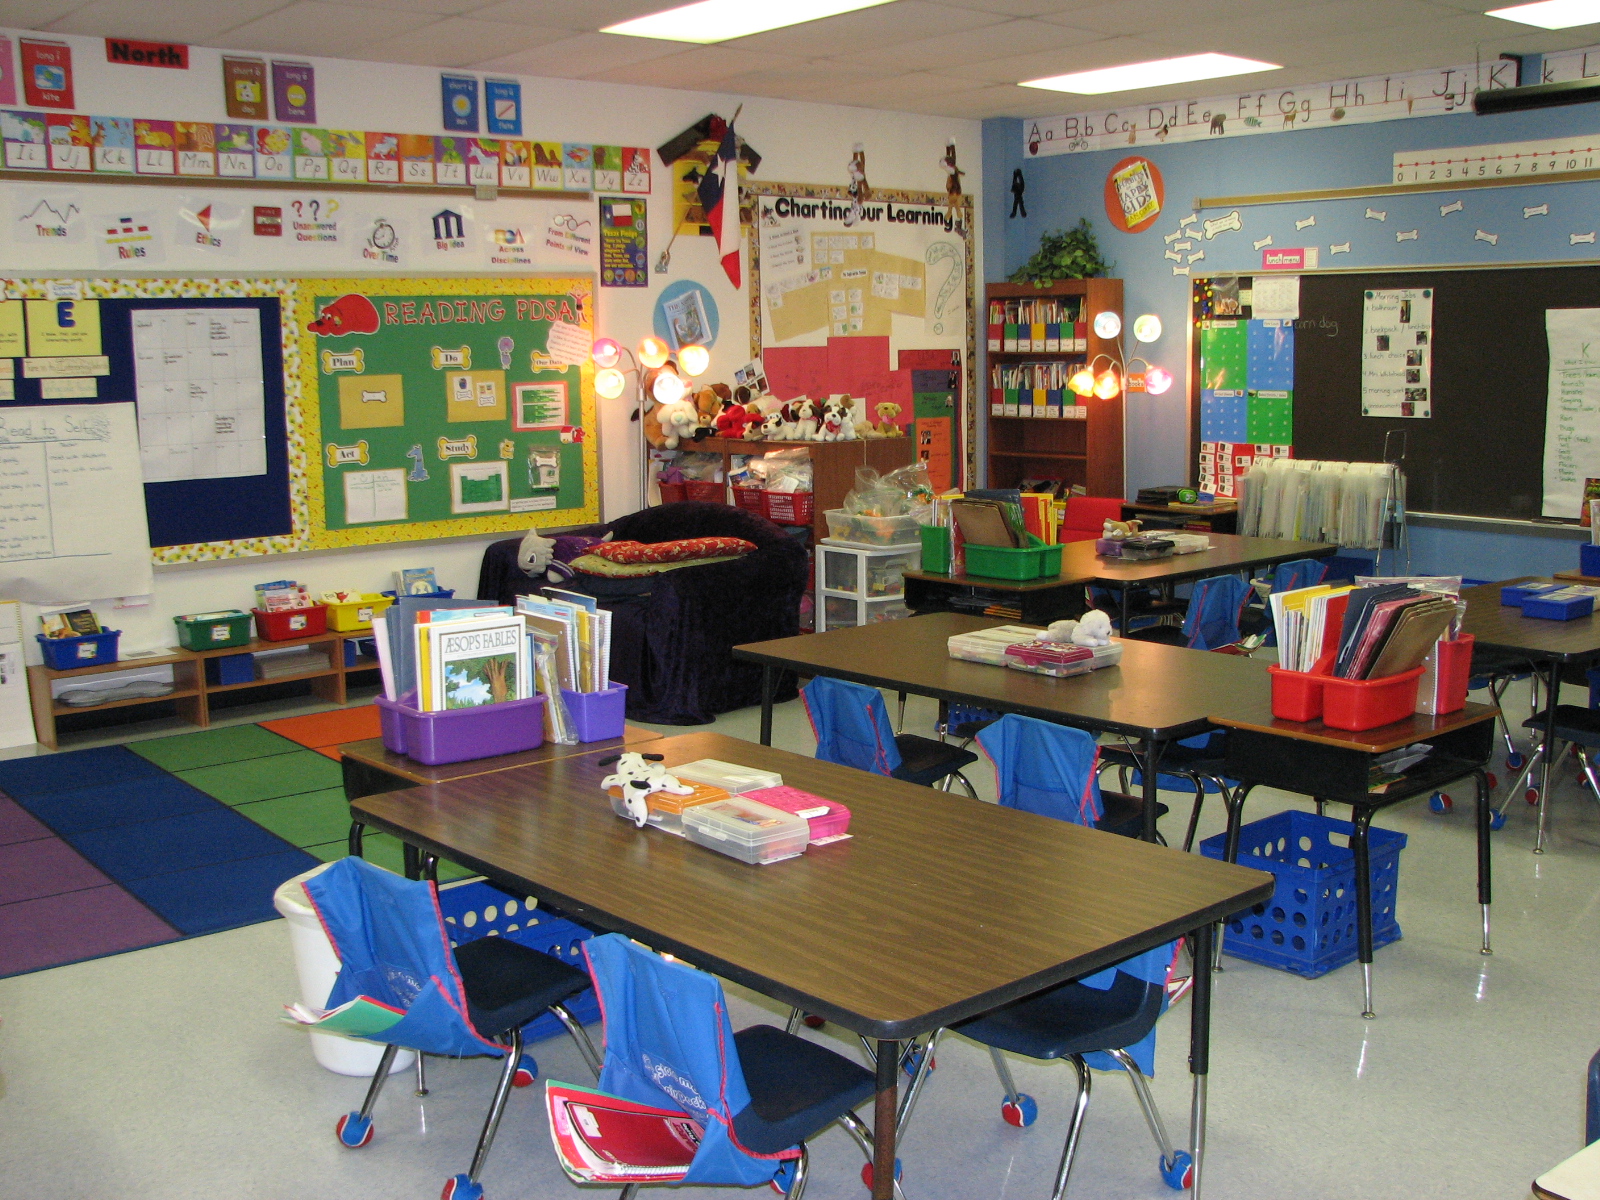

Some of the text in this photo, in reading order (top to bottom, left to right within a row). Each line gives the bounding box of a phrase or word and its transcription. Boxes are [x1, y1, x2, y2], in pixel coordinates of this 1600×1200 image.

[110, 41, 182, 66] North
[1397, 172, 1404, 182] 0
[1429, 169, 1436, 180] 2
[1445, 168, 1453, 178] 3
[1461, 166, 1469, 177] 4
[1478, 165, 1486, 176] 5
[1495, 164, 1502, 175] 6
[1513, 163, 1521, 174] 7
[1530, 161, 1538, 172] 8
[1548, 160, 1556, 171] 9
[1566, 159, 1577, 170] 10
[1584, 157, 1593, 168] 11
[775, 197, 854, 228] Charting
[887, 203, 953, 234] Learning
[36, 224, 67, 237] Trends
[296, 232, 337, 242] Questions
[548, 227, 564, 238] From
[196, 232, 222, 248] Ethics
[436, 241, 449, 251] Big
[118, 245, 147, 260] Rules
[363, 247, 399, 264] Over Time
[499, 245, 525, 254] Across
[574, 246, 589, 256] View
[491, 256, 531, 265] Disciplines
[1267, 253, 1300, 265] lunch menu
[1374, 290, 1416, 304] Morning Jobs
[57, 301, 76, 328] E
[385, 299, 574, 324] READING PDSA
[1371, 304, 1398, 312] bathroom
[1318, 315, 1339, 337] dog
[1581, 342, 1590, 358] K
[332, 356, 355, 368] Plan
[444, 352, 458, 364] Do
[42, 418, 56, 435] to
[340, 449, 355, 459] Act
[445, 443, 470, 454] Study
[482, 629, 517, 649] FABLES
